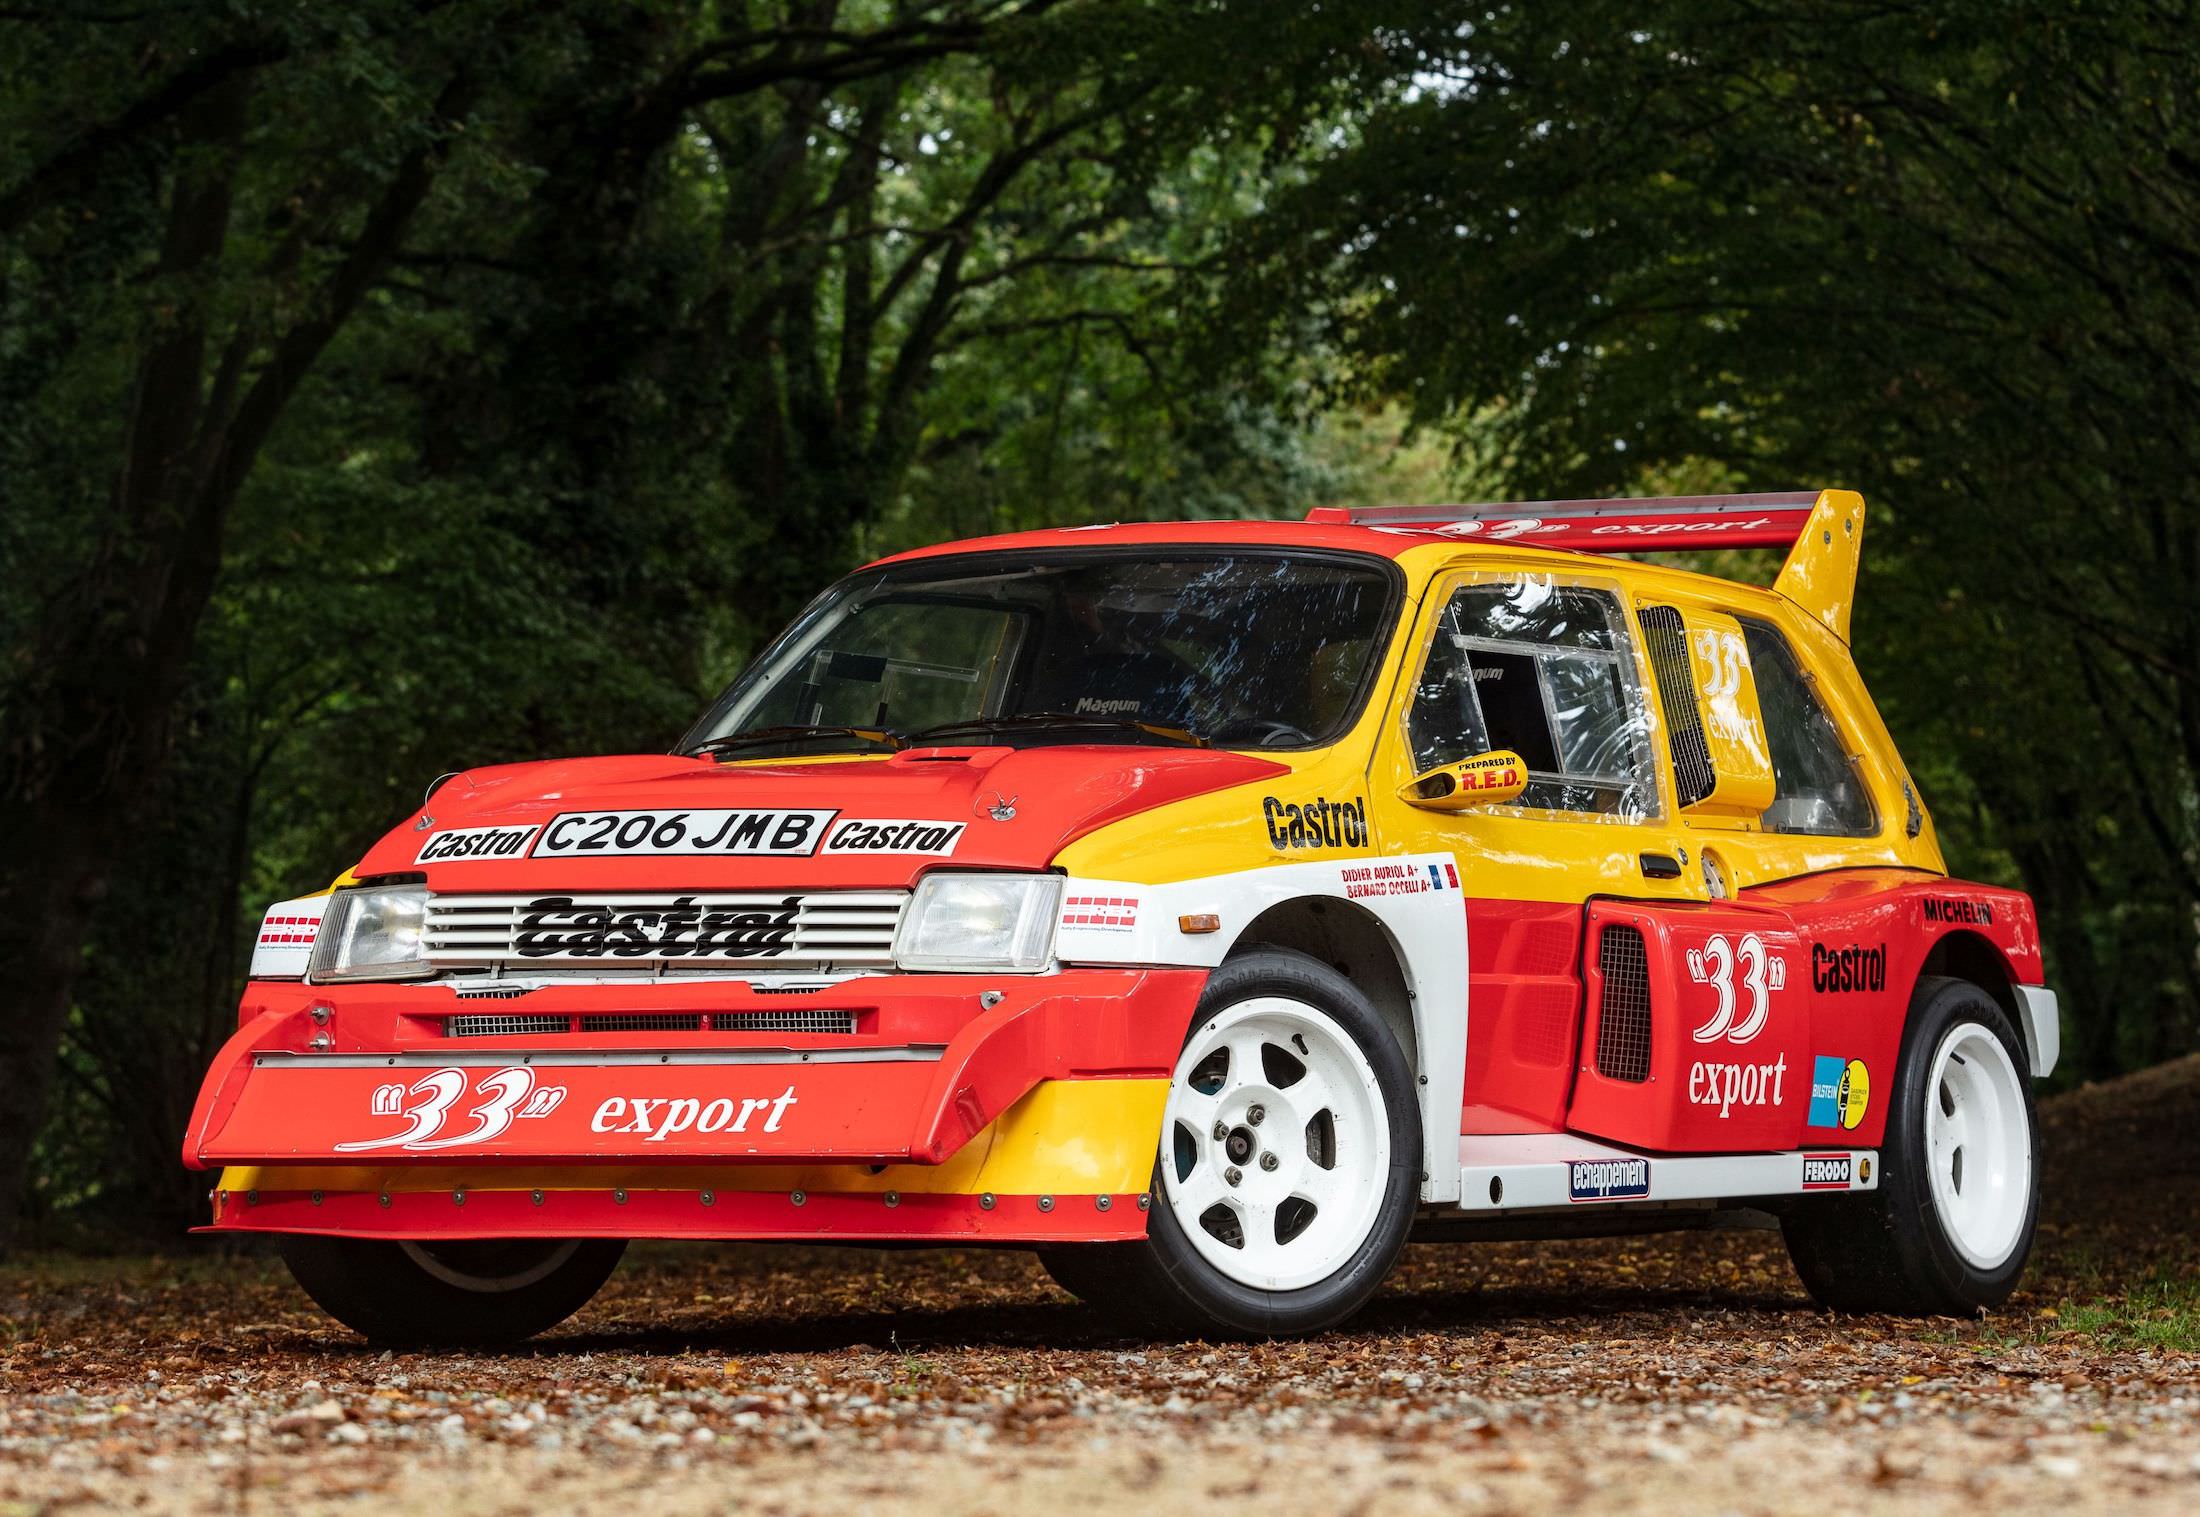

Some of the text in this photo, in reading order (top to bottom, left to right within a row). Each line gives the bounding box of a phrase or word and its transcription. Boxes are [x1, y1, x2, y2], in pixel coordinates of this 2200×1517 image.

[1591, 517, 1772, 535] export
[1074, 697, 1140, 715] Magnum
[1458, 757, 1516, 771] PREPARED BY
[1461, 768, 1522, 790] R.E.D.
[546, 813, 815, 851] C206 JMB
[1262, 796, 1369, 850] Castrol
[419, 827, 540, 860] Castrol
[828, 822, 964, 852] Castrol
[1341, 867, 1372, 883] DIDIER
[1374, 866, 1405, 879] AURIOL
[1346, 882, 1387, 899] BERNARD
[1388, 880, 1419, 896] OCCELLI
[1923, 898, 1993, 925] MICHELIN
[518, 896, 806, 957] Castrol
[1812, 943, 1886, 994] Castrol
[1688, 1051, 1787, 1119] export
[1813, 1083, 1837, 1099] BILSTEIN
[590, 1086, 798, 1142] export
[1804, 1161, 1850, 1181] FERODO
